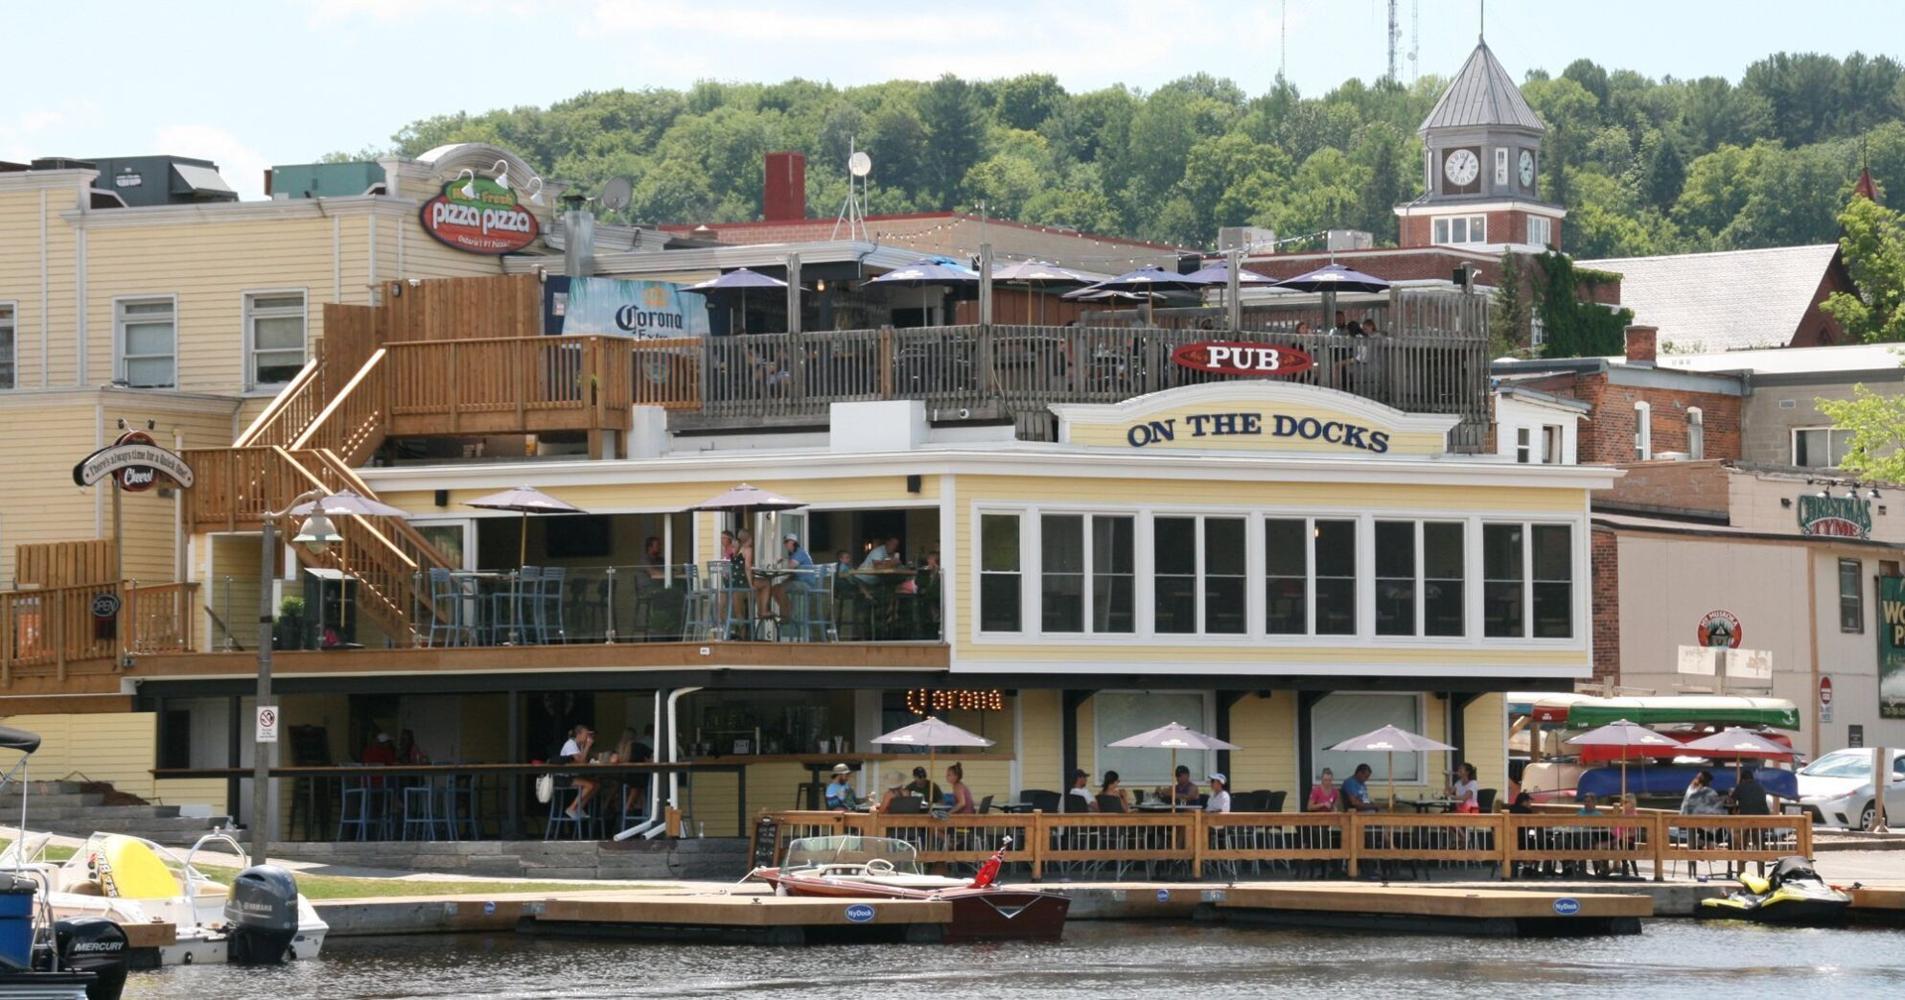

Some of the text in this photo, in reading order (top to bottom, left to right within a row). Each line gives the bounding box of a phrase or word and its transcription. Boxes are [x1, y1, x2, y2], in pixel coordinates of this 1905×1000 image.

[433, 202, 530, 235] pizza pizza
[615, 304, 683, 334] Corona
[638, 329, 671, 339] Ext
[1206, 346, 1279, 370] PUB
[1127, 413, 1390, 453] ON THE DOCKS
[131, 449, 145, 460] time
[1797, 495, 1872, 532] CHRISTMAS
[93, 599, 118, 612] OPEN
[74, 942, 124, 952] MERCURY
